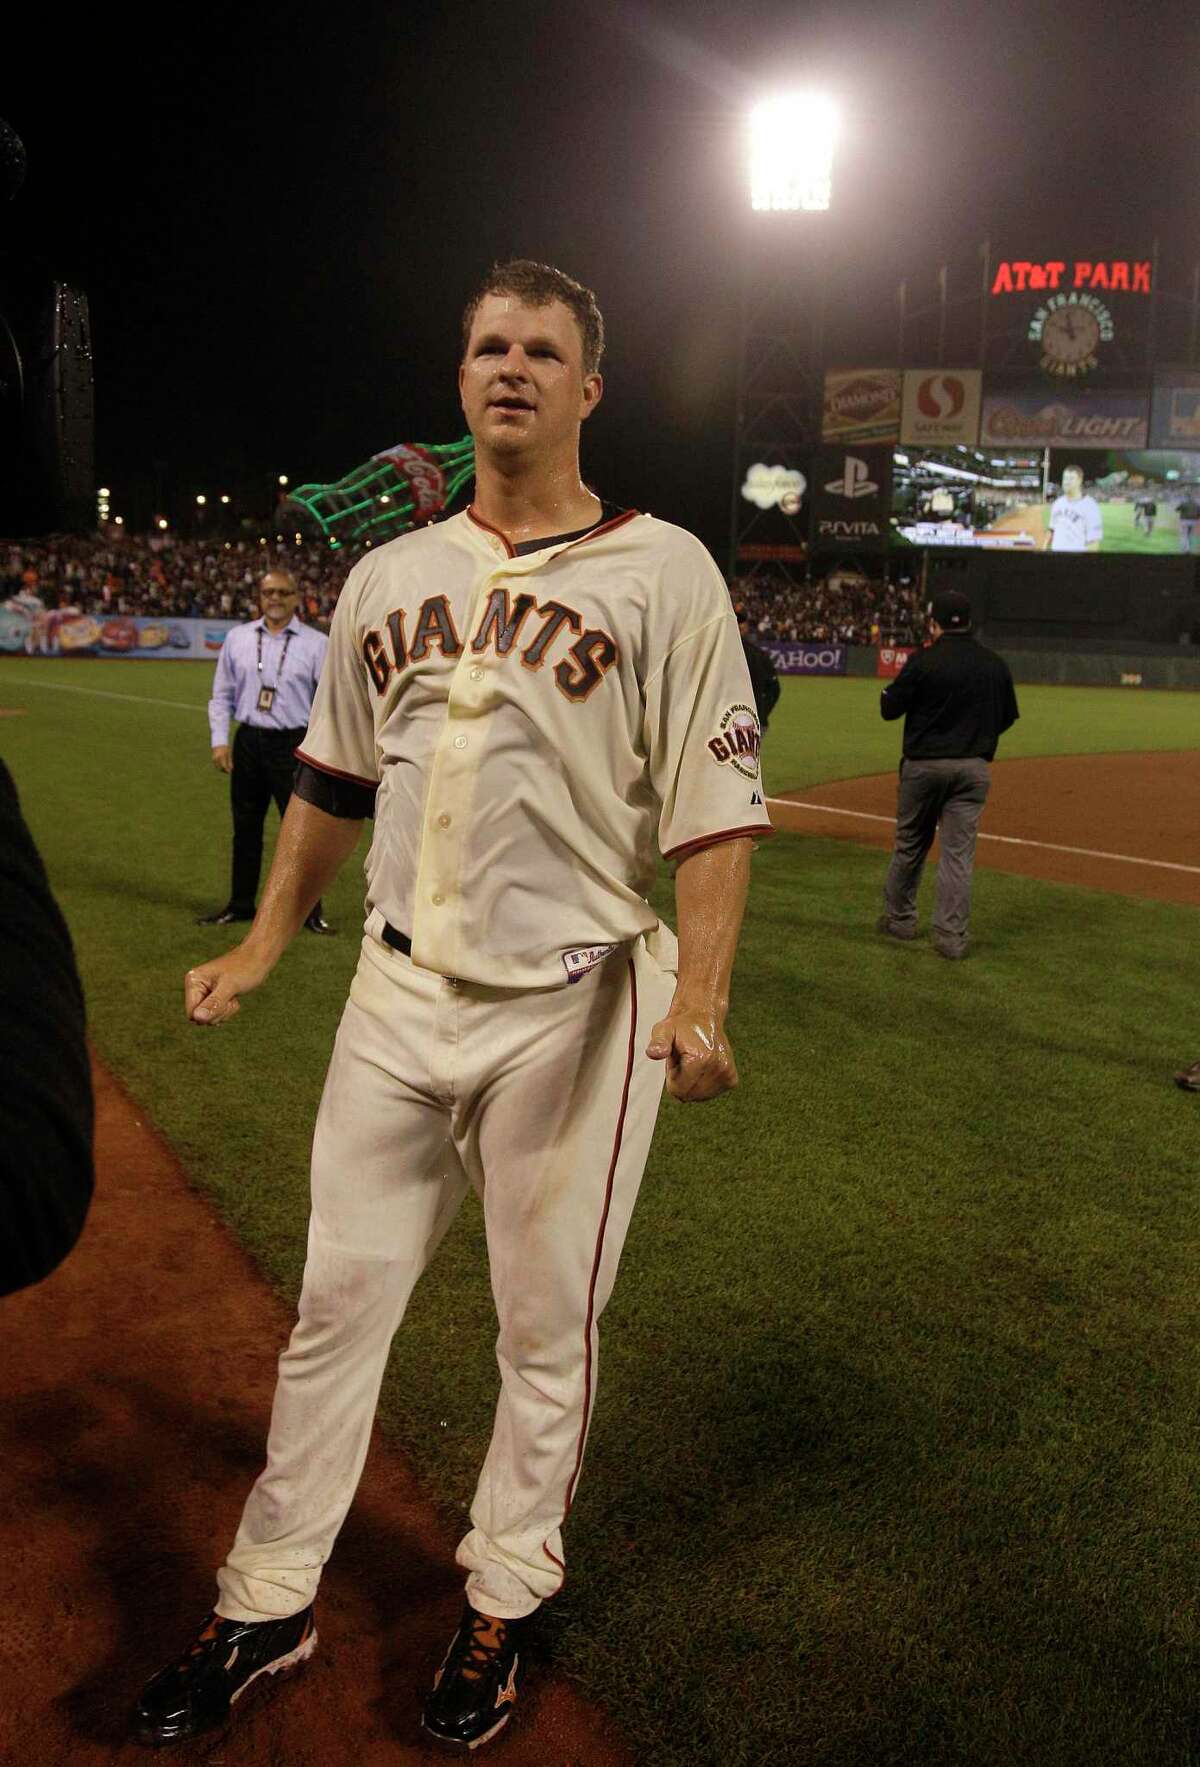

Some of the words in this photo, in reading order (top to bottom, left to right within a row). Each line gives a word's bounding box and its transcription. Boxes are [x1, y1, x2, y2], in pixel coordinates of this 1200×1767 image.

[992, 262, 1065, 295] AT&T
[1073, 262, 1151, 294] PARK
[1027, 307, 1049, 341] SAN
[1047, 291, 1114, 342] FRANCISCO
[1061, 416, 1141, 435] LIGHT
[362, 587, 618, 703] GIANTS
